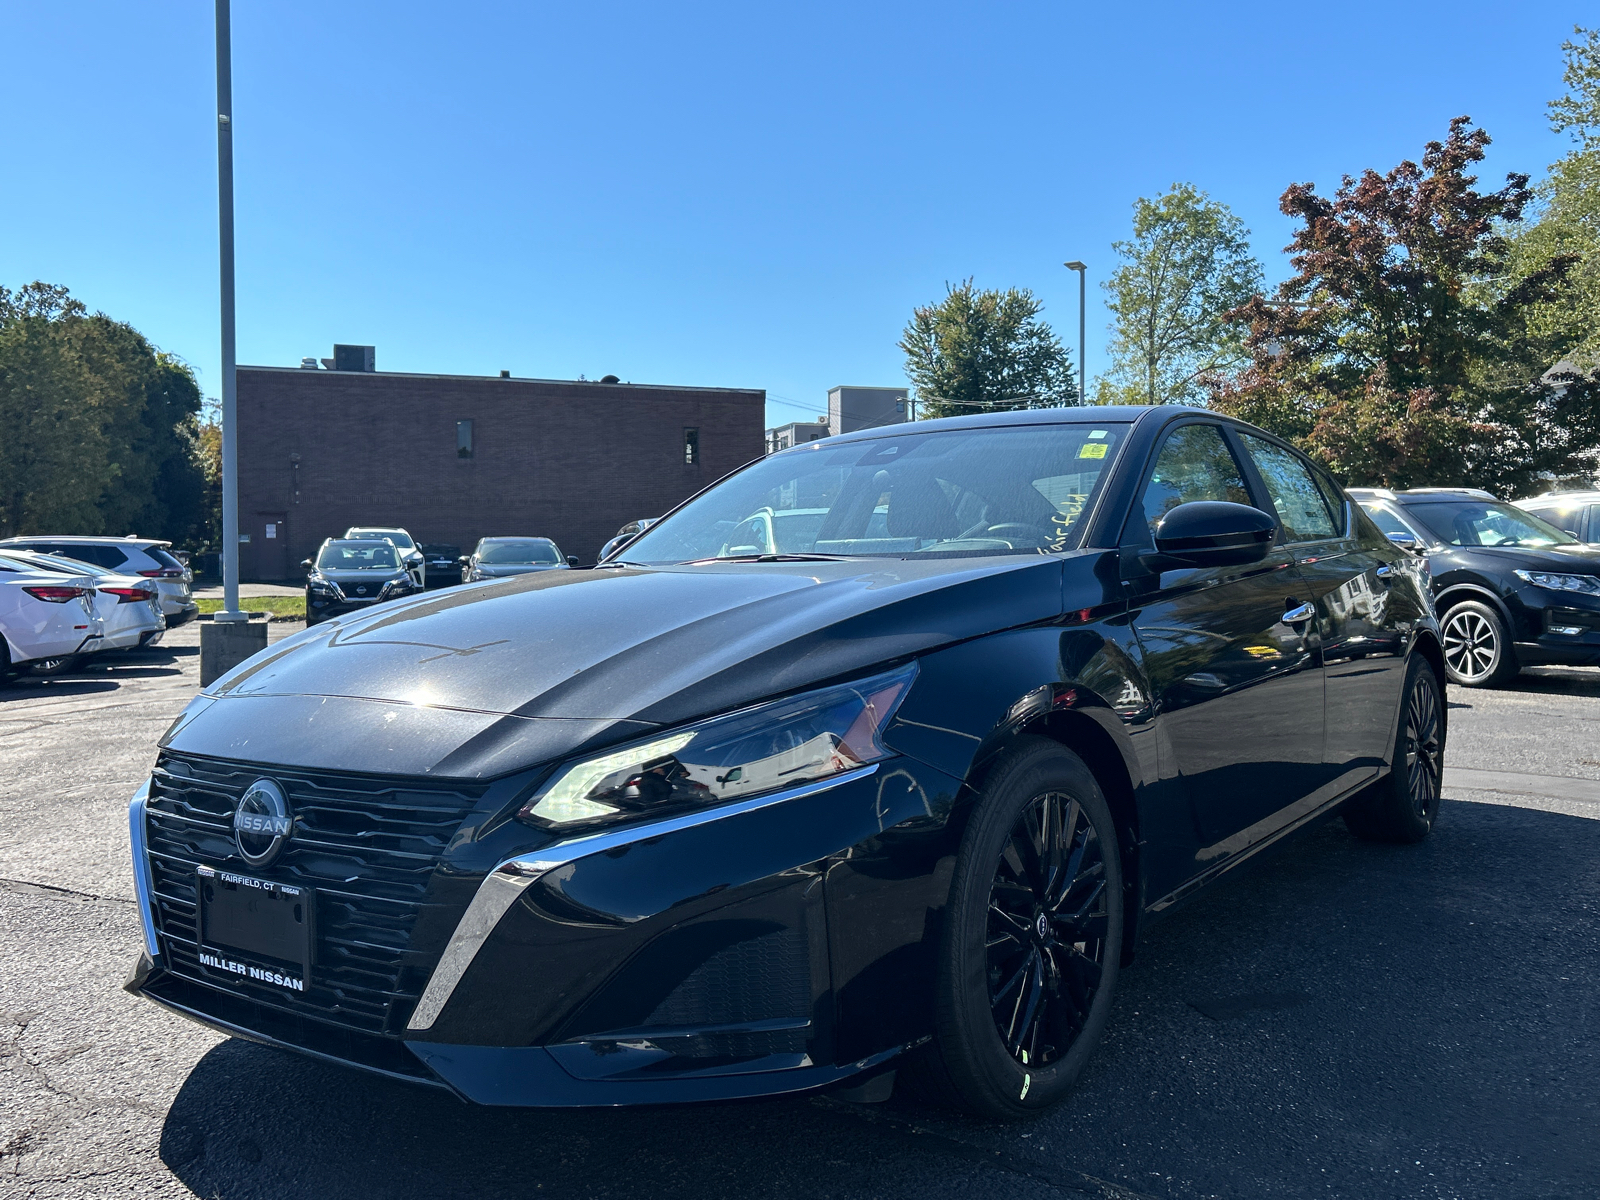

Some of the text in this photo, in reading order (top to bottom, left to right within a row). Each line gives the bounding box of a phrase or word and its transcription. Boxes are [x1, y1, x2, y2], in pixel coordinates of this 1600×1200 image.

[234, 812, 288, 834] NISSAN
[221, 873, 275, 891] FAIRFIELD, CT
[199, 953, 304, 992] MILLER NISSAN
